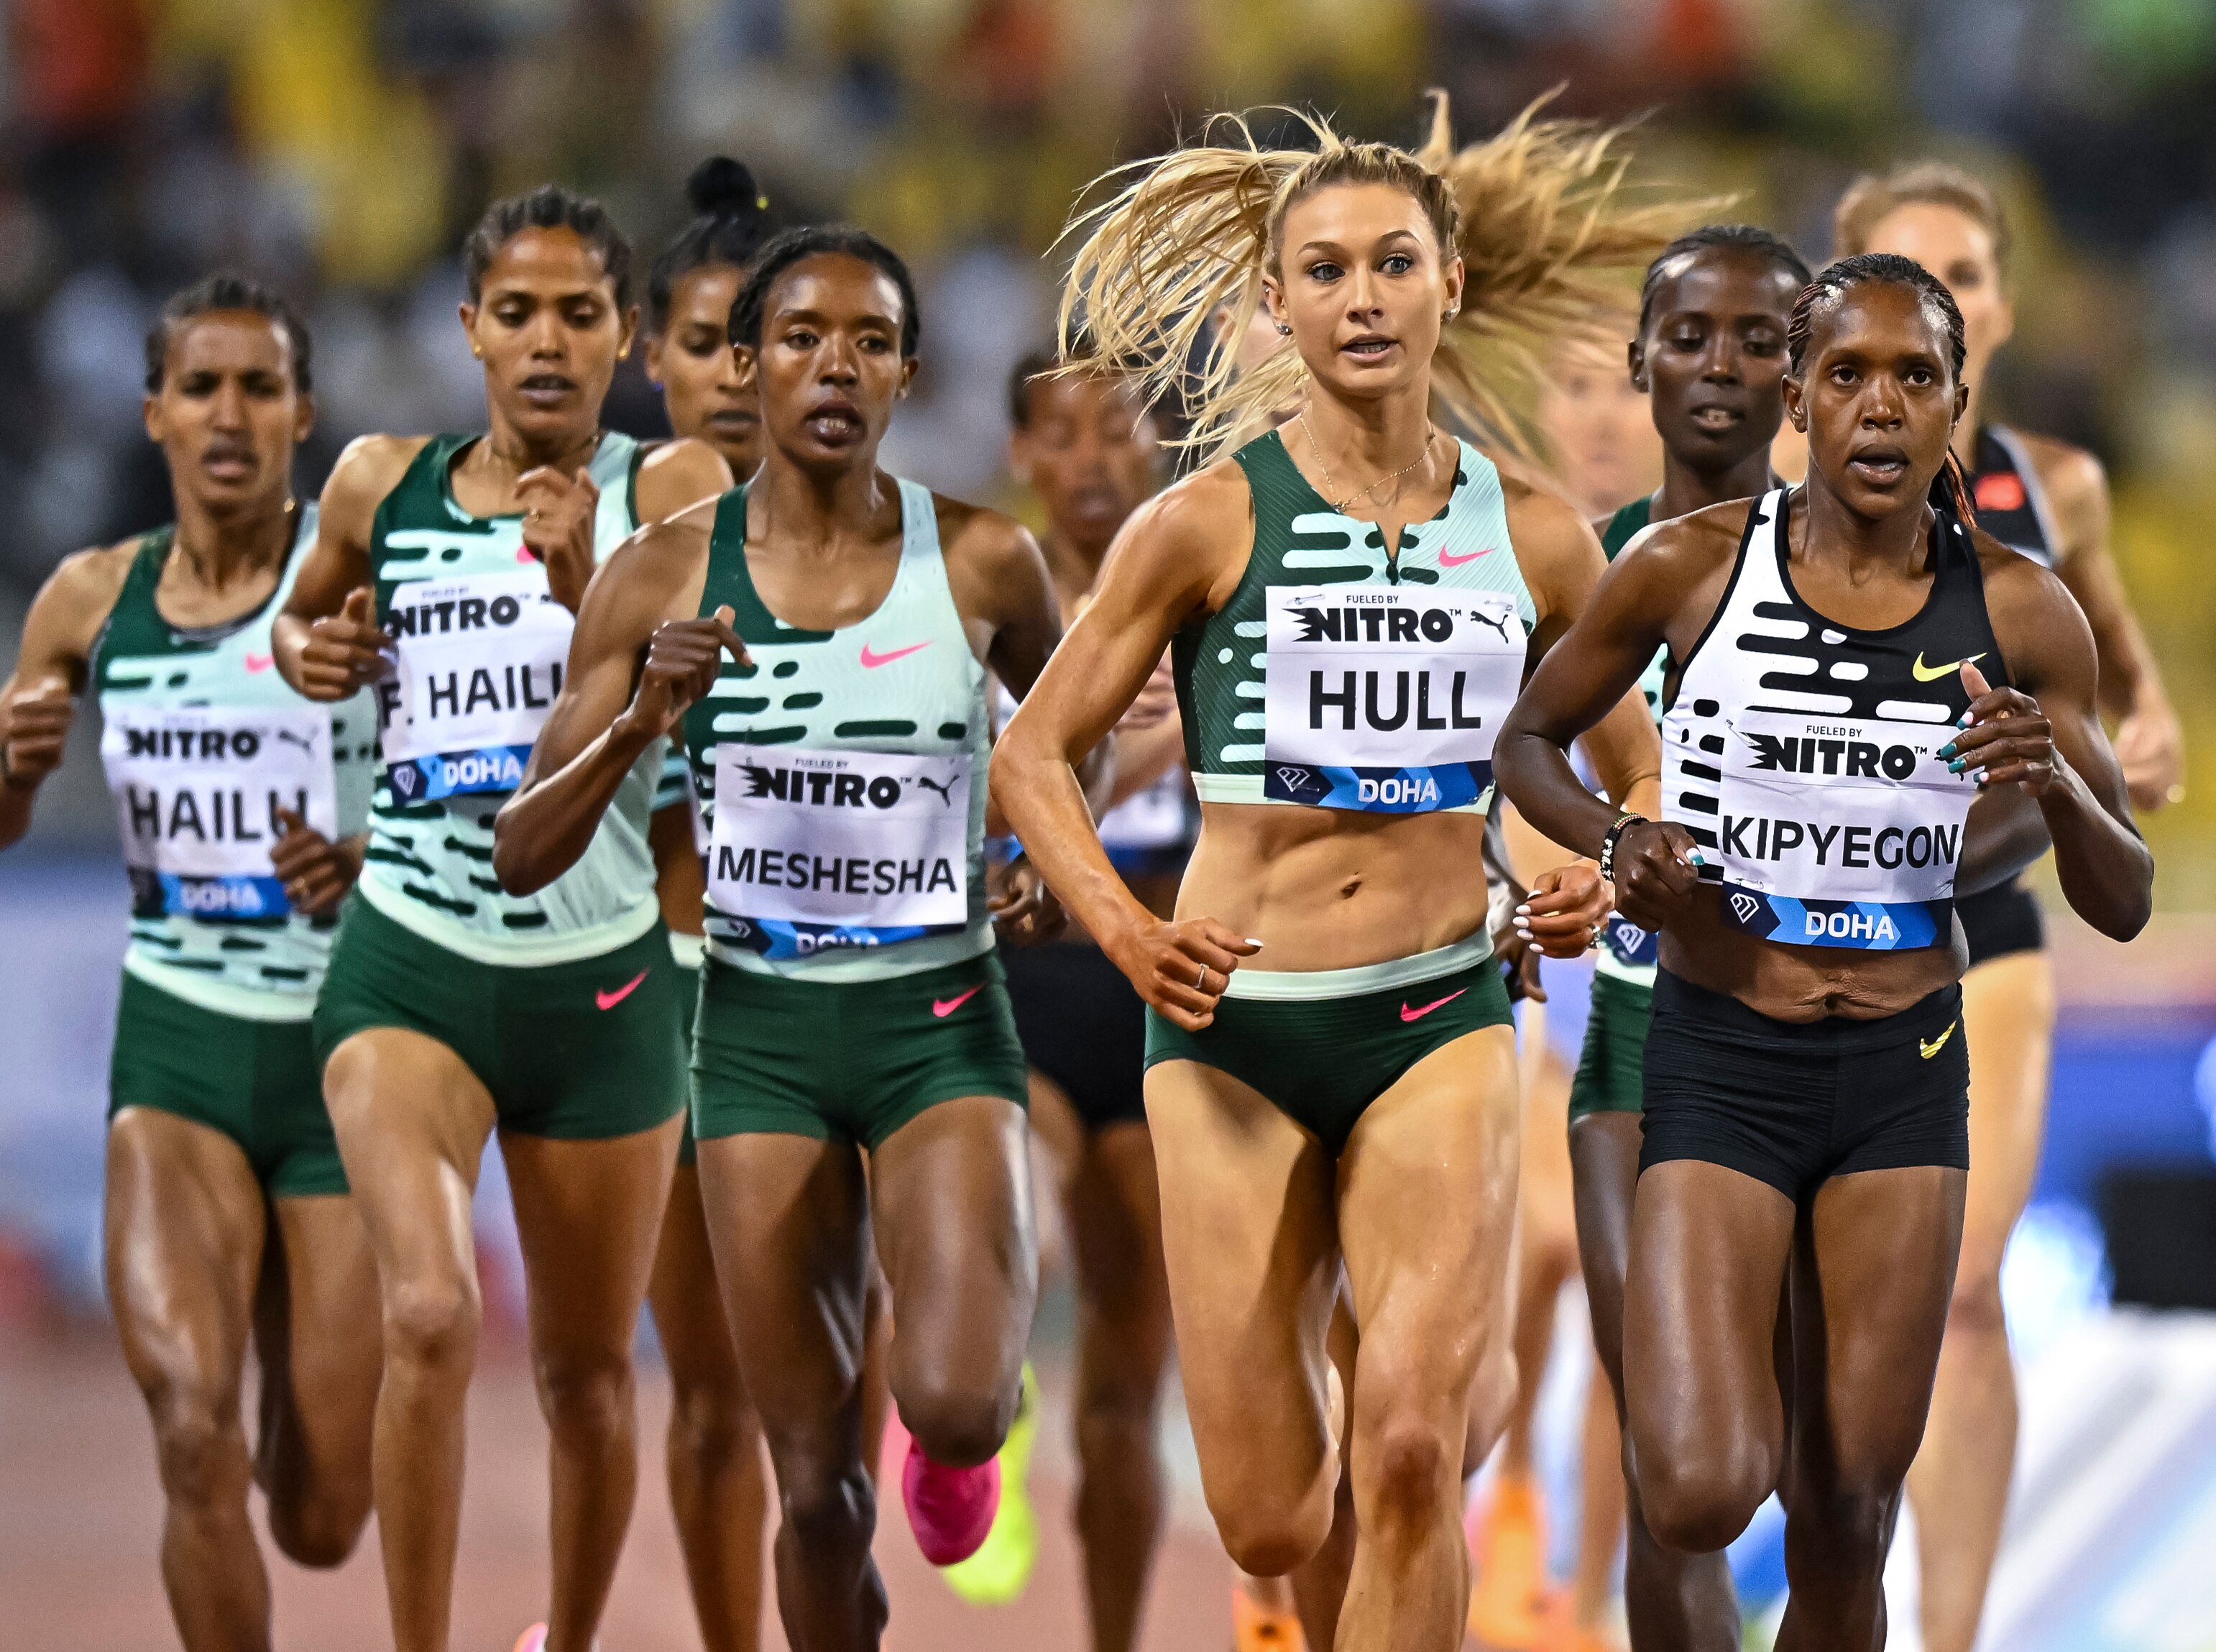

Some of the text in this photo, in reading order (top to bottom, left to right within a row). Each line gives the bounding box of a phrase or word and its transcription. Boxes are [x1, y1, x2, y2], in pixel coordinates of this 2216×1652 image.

[389, 596, 520, 638] NITRO
[1346, 595, 1399, 604] FUELED BY
[1282, 607, 1453, 643] NITRO
[380, 683, 414, 728] F.
[1309, 670, 1481, 732] HULL
[123, 728, 260, 760] NITRO
[1806, 725, 1863, 738] FUELED BY
[443, 757, 525, 788] DOHA
[1739, 731, 1916, 781] NITRO
[732, 763, 901, 809] NITRO
[1358, 778, 1438, 804] DOHA
[1721, 814, 1960, 871] KIPYEGON
[717, 845, 958, 896] MESHESHA
[1805, 912, 1895, 940] DOHA
